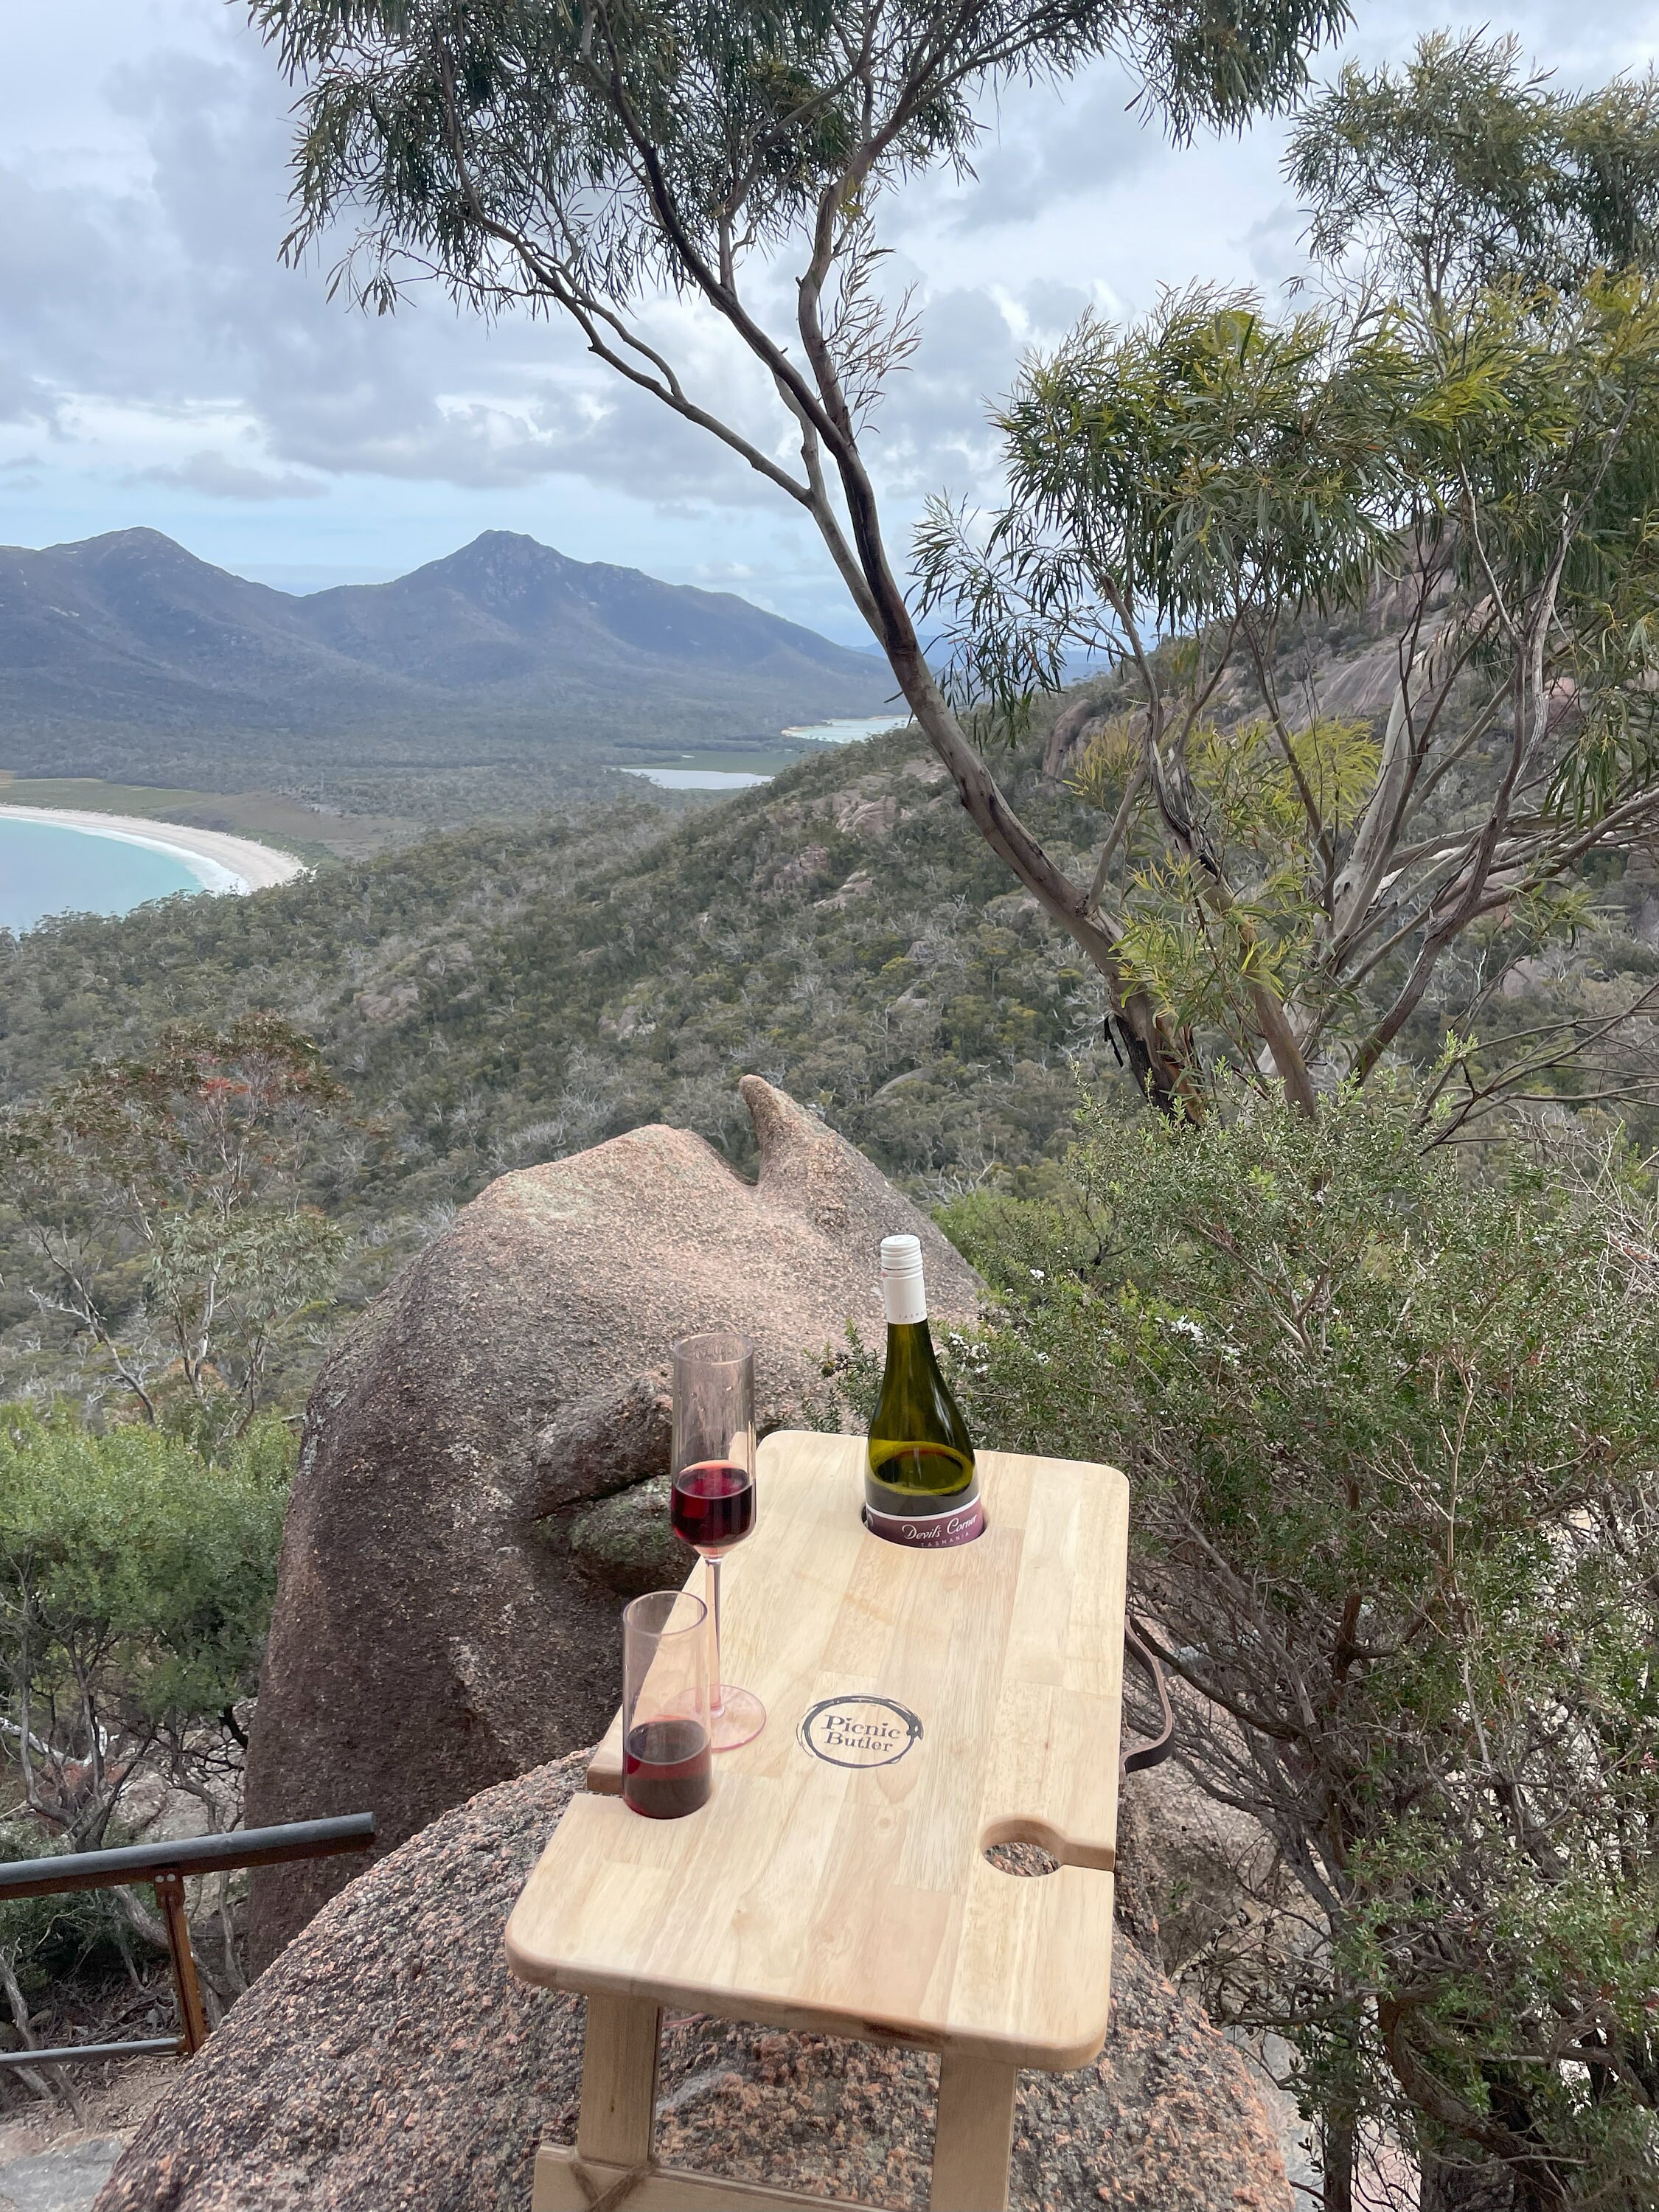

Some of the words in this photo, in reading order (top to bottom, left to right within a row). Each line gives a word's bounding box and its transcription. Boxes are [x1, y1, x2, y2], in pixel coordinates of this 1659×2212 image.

[902, 1524, 942, 1540] Devil's
[947, 1514, 978, 1534] Corner
[920, 1531, 970, 1547] TASMANIA
[821, 1714, 901, 1739] Picnic
[823, 1731, 894, 1752] Butler
